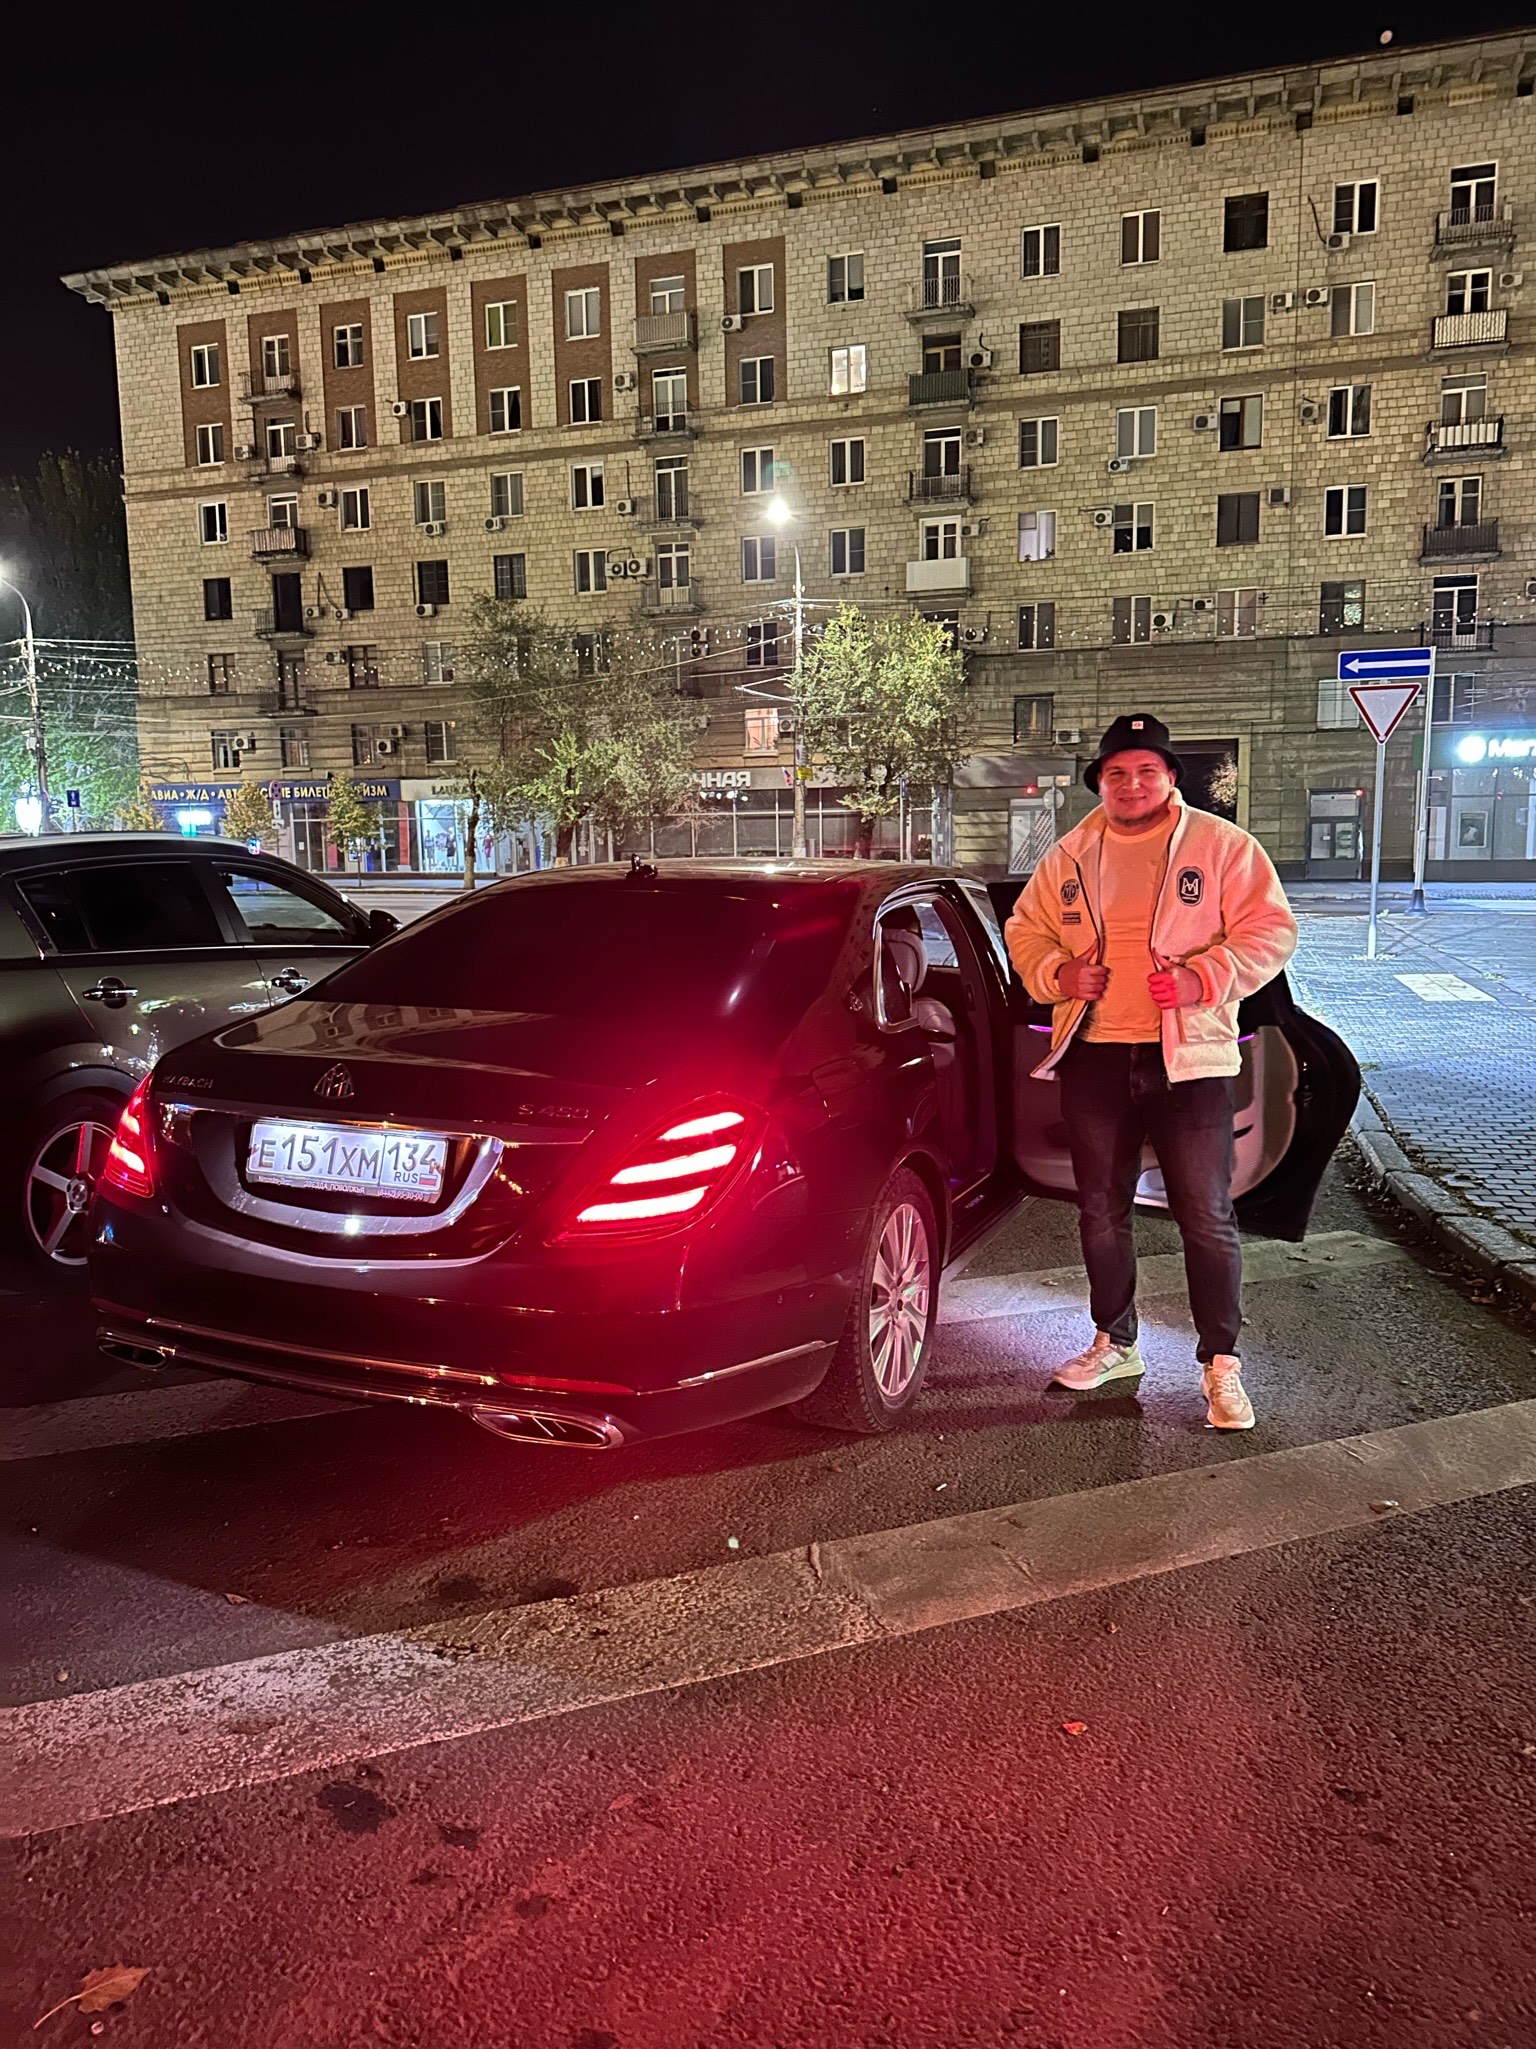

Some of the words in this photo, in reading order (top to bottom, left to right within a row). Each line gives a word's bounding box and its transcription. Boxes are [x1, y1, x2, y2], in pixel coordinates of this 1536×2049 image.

[152, 789, 179, 801] АВИА
[186, 788, 210, 801] Ж/Д
[518, 1103, 534, 1115] S
[387, 1141, 437, 1175] 134
[393, 1171, 418, 1184] RUS
